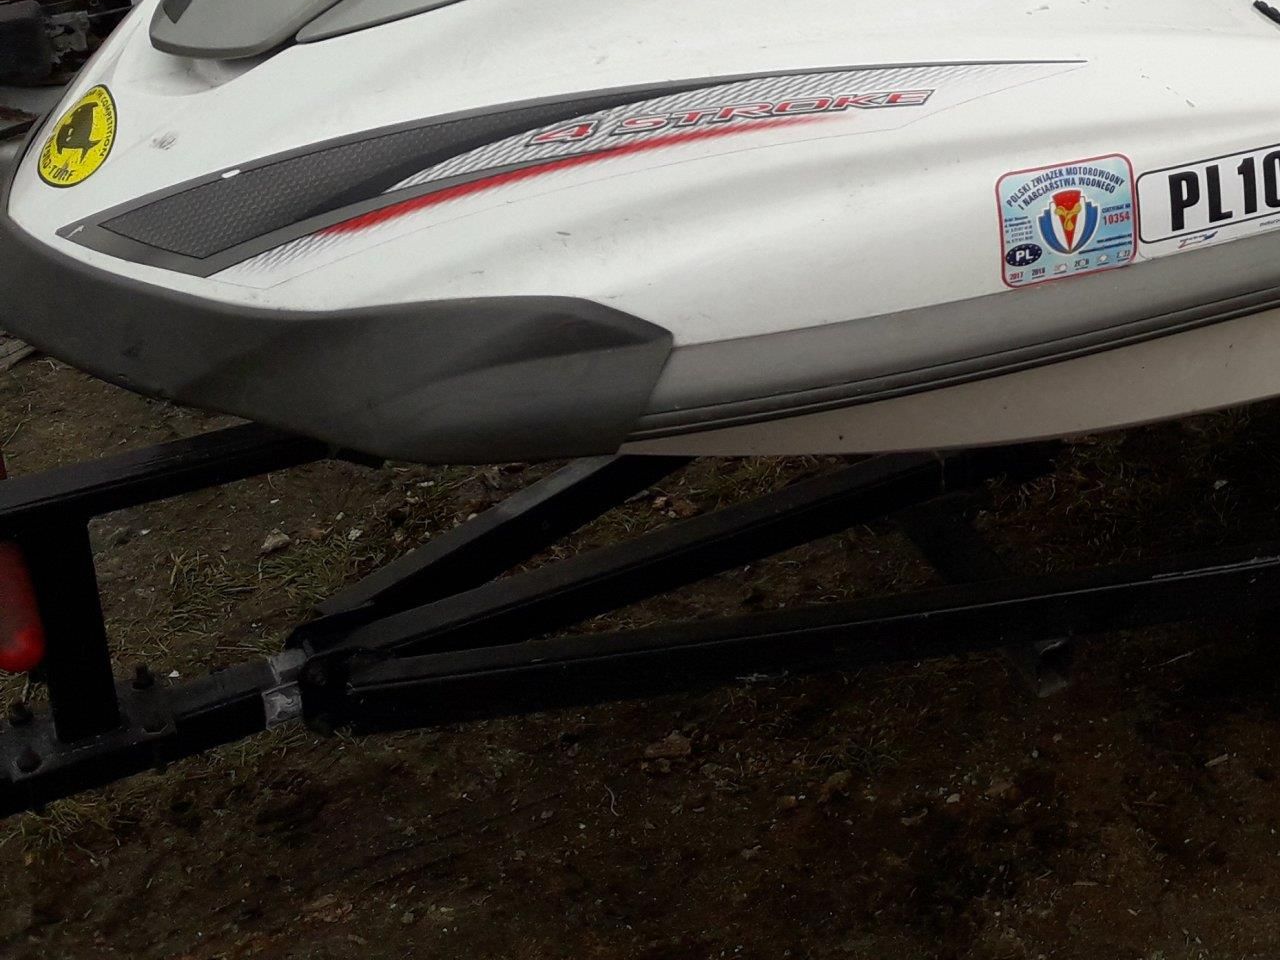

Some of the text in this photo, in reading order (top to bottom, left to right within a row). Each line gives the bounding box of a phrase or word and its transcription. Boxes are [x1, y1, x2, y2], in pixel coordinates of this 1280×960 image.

[524, 88, 936, 148] 4 STROKE
[1006, 183, 1032, 208] POLSKI
[1065, 166, 1126, 187] MOTOROWODNY
[1022, 176, 1077, 207] NARCIARSTWA
[1078, 176, 1117, 194] WODNEGO
[1103, 211, 1131, 226] 10354
[1015, 248, 1035, 262] PL
